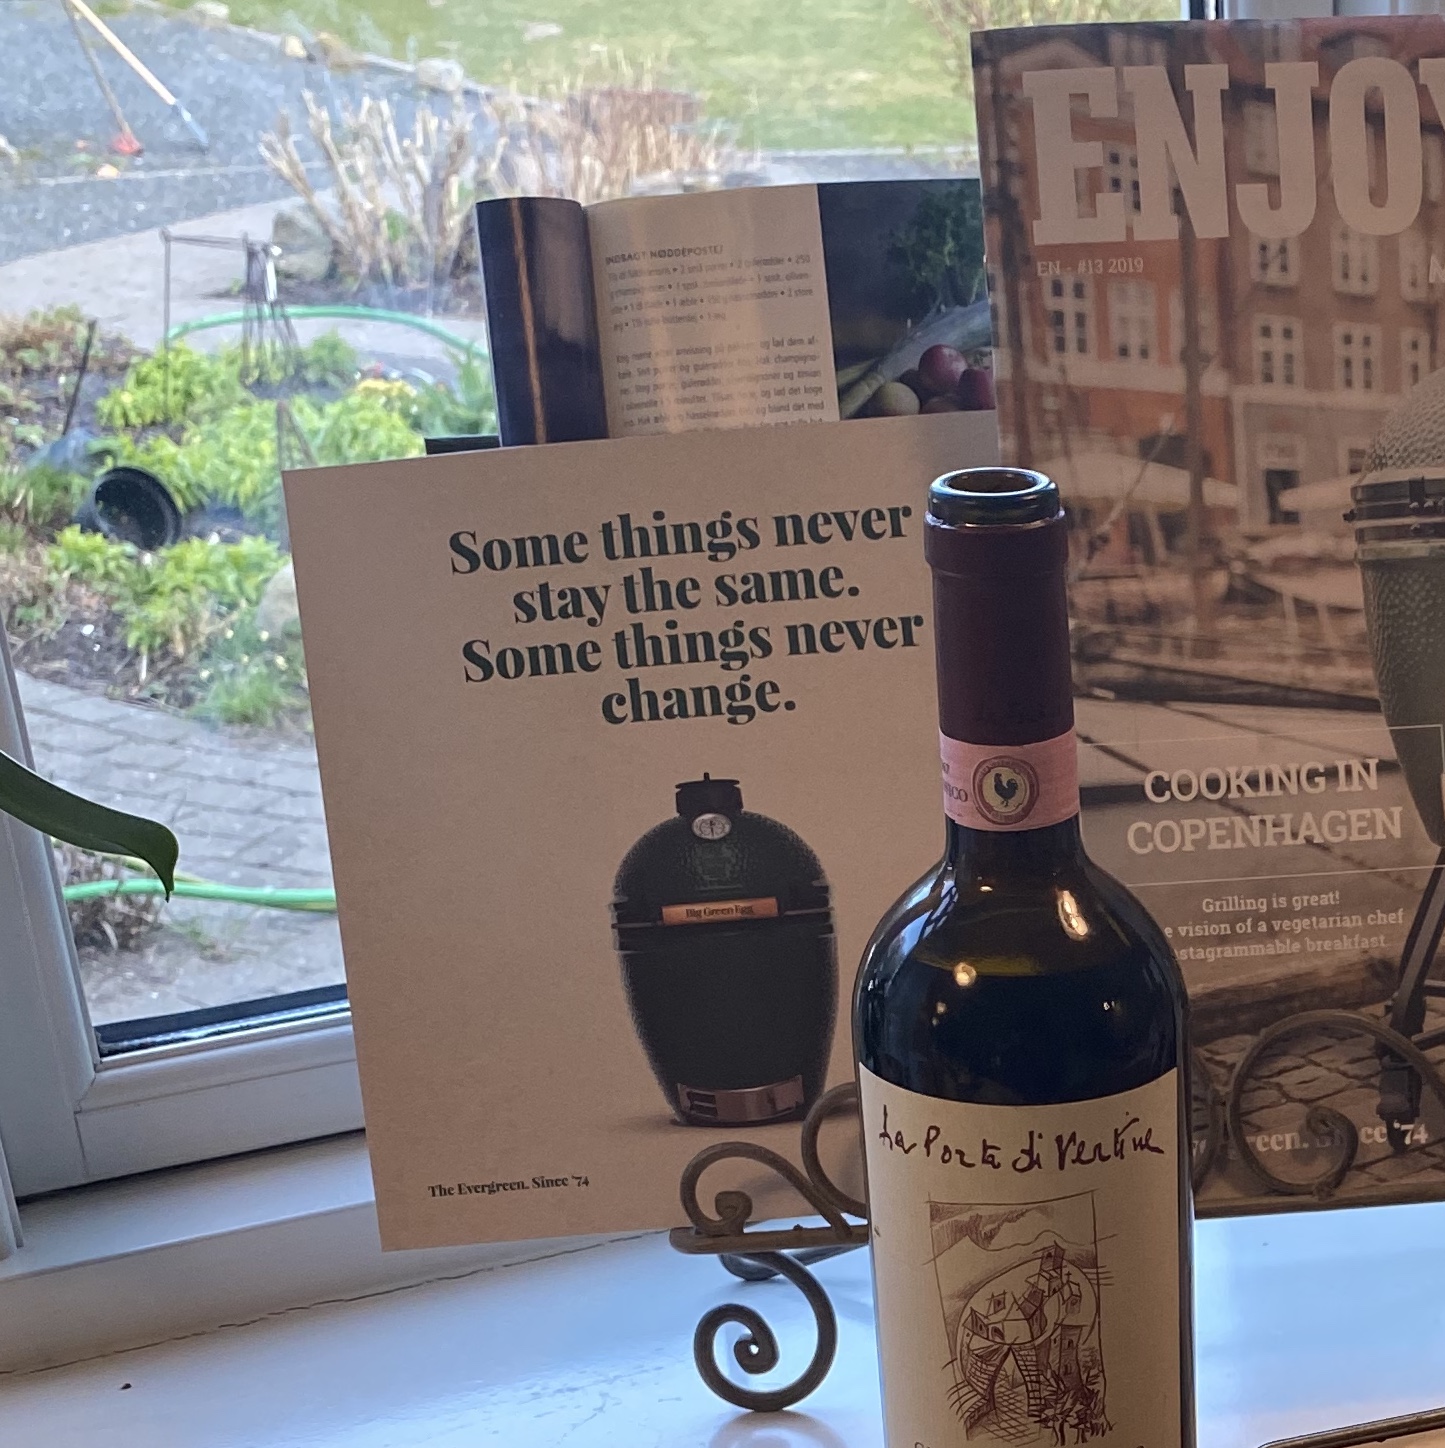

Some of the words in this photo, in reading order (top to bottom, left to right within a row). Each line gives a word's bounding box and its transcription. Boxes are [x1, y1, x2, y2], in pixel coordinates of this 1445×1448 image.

[1037, 260, 1060, 276] EN
[1078, 259, 1103, 275] #13
[1107, 257, 1144, 273] 2019
[449, 528, 590, 576] Some
[600, 510, 761, 563] things
[774, 503, 912, 547] never
[513, 580, 612, 628] stay
[623, 567, 701, 614] the
[715, 564, 861, 608] same.
[461, 637, 601, 684] Some
[613, 620, 774, 672] things
[786, 613, 924, 657] never
[602, 674, 797, 725] change.
[1144, 761, 1327, 803] COOKING
[1334, 758, 1379, 793] IN
[1127, 806, 1403, 855] COPENHAGEN
[686, 908, 702, 919] Big
[704, 906, 734, 917] Green
[1178, 920, 1231, 938] vision
[1236, 918, 1253, 935] of
[1258, 921, 1267, 934] a
[1272, 912, 1362, 934] vegetarian
[1367, 908, 1405, 926] chef
[1202, 894, 1267, 914] Grilling
[1272, 893, 1287, 909] is
[1292, 890, 1340, 911] great!
[1174, 937, 1300, 963] stagrammable
[1305, 933, 1387, 953] breakfast
[1012, 1130, 1043, 1173] di
[428, 1184, 454, 1198] The
[457, 1180, 529, 1195] Evergreen.
[532, 1175, 569, 1188] Since
